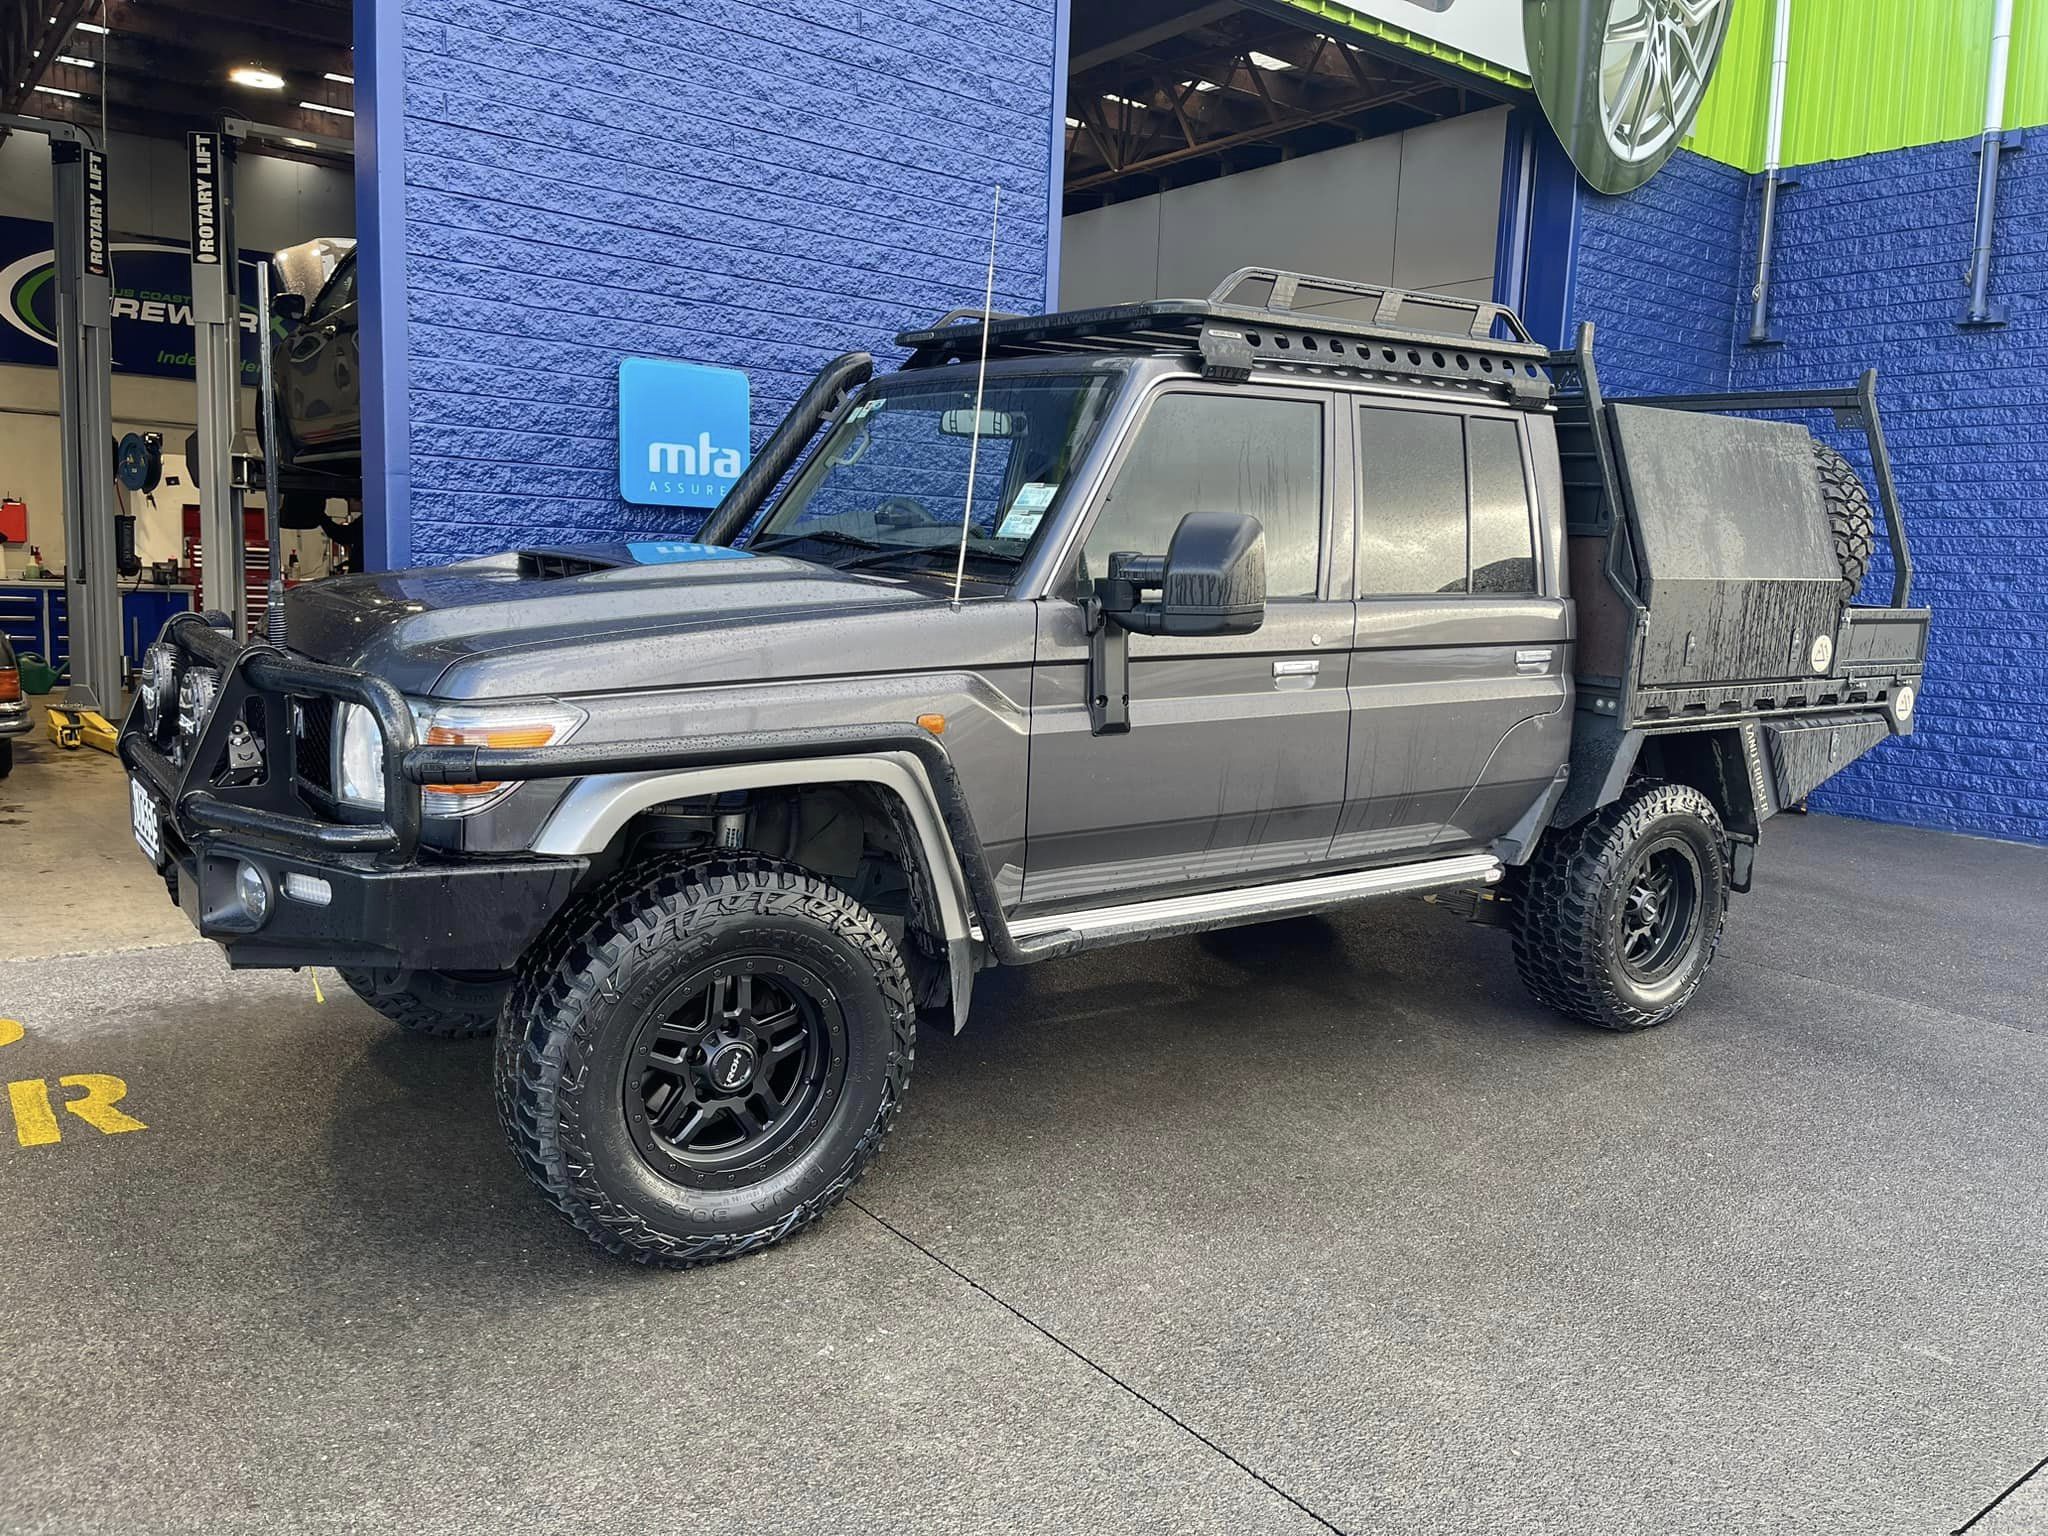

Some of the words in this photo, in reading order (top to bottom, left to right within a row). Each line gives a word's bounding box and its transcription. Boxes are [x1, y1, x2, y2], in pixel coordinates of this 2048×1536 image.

[89, 151, 103, 192] LIFT
[195, 133, 212, 174] LIFT
[89, 193, 103, 266] ROTARY
[196, 179, 215, 253] ROTARY
[648, 431, 741, 479] mta
[1745, 723, 1758, 758] LAND
[1752, 758, 1770, 813] CRUISER
